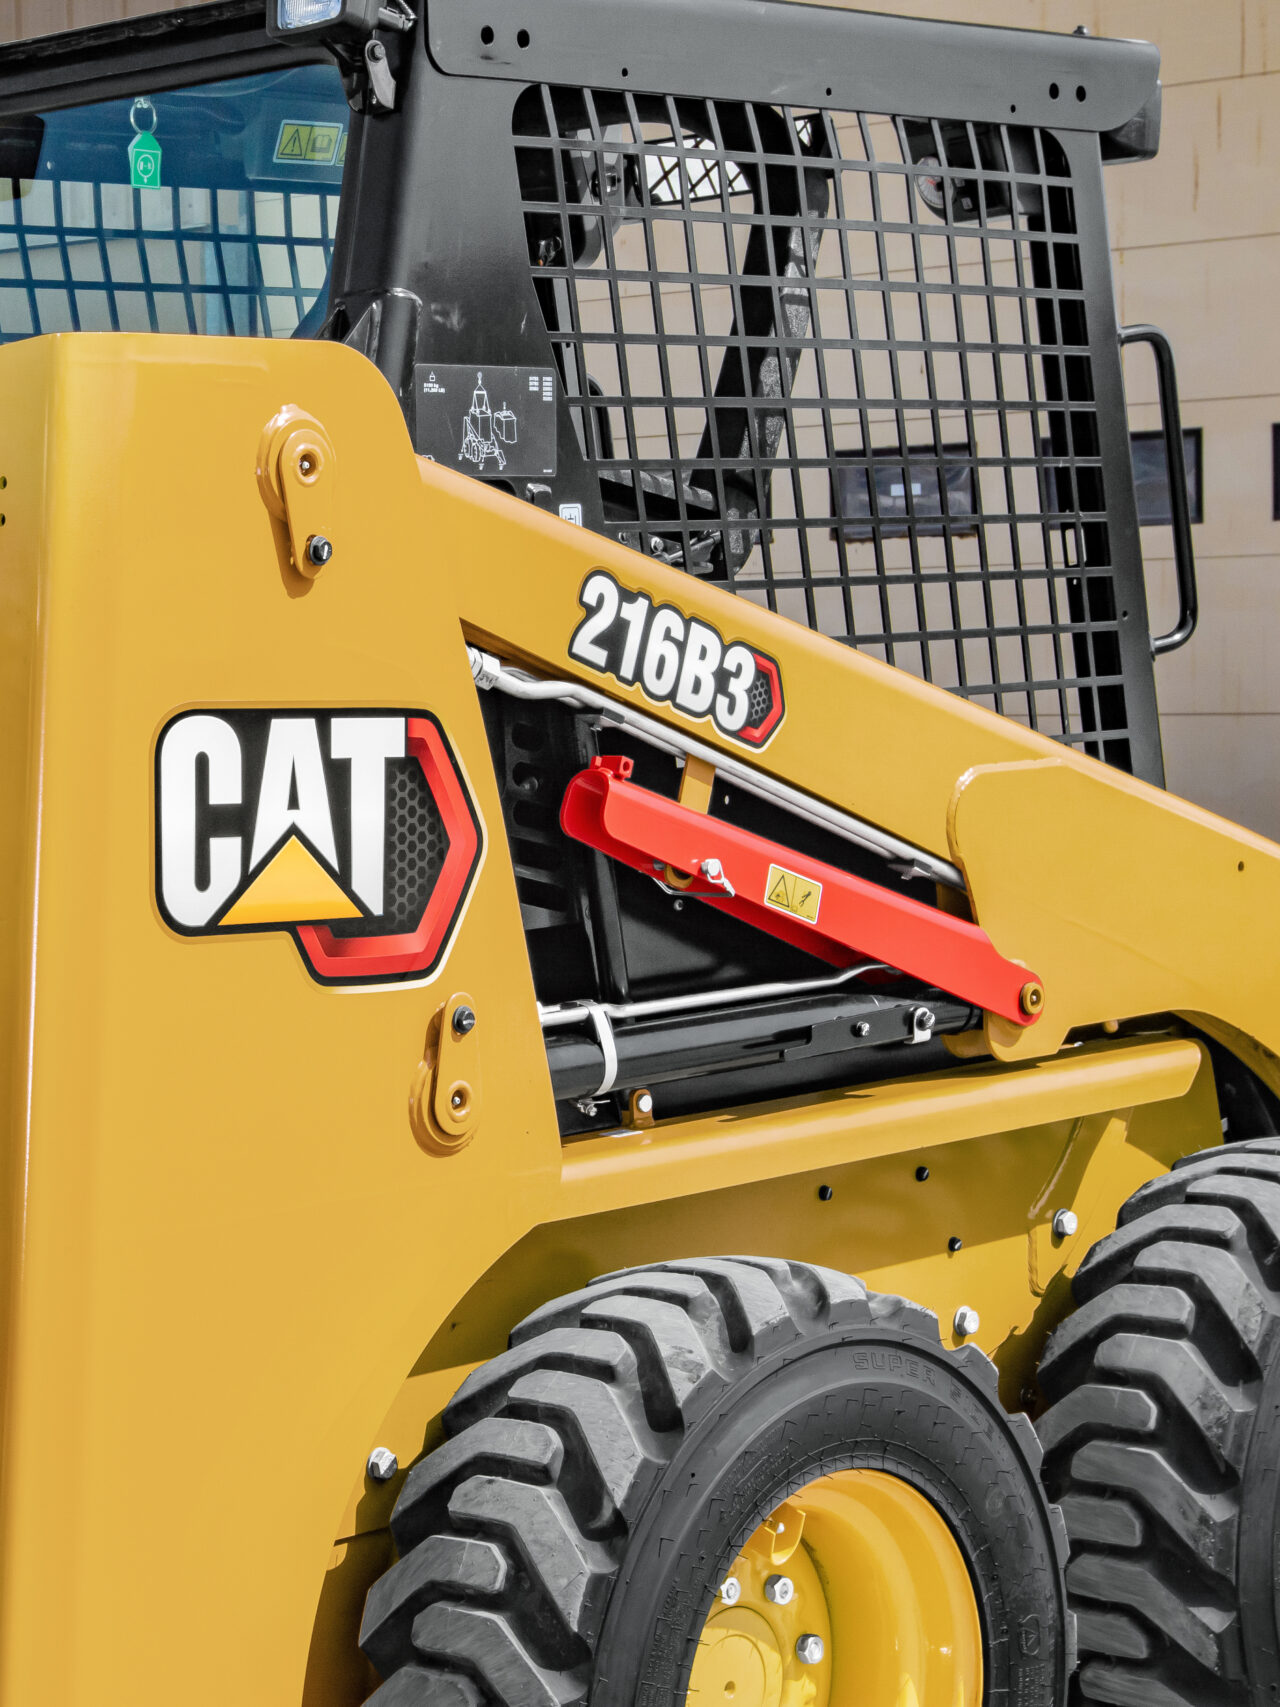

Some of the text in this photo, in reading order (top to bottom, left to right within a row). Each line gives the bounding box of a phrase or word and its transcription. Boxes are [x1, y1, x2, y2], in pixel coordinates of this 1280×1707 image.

[571, 575, 756, 732] 216B3
[161, 715, 406, 928] CAT
[852, 1352, 936, 1386] SUPER
